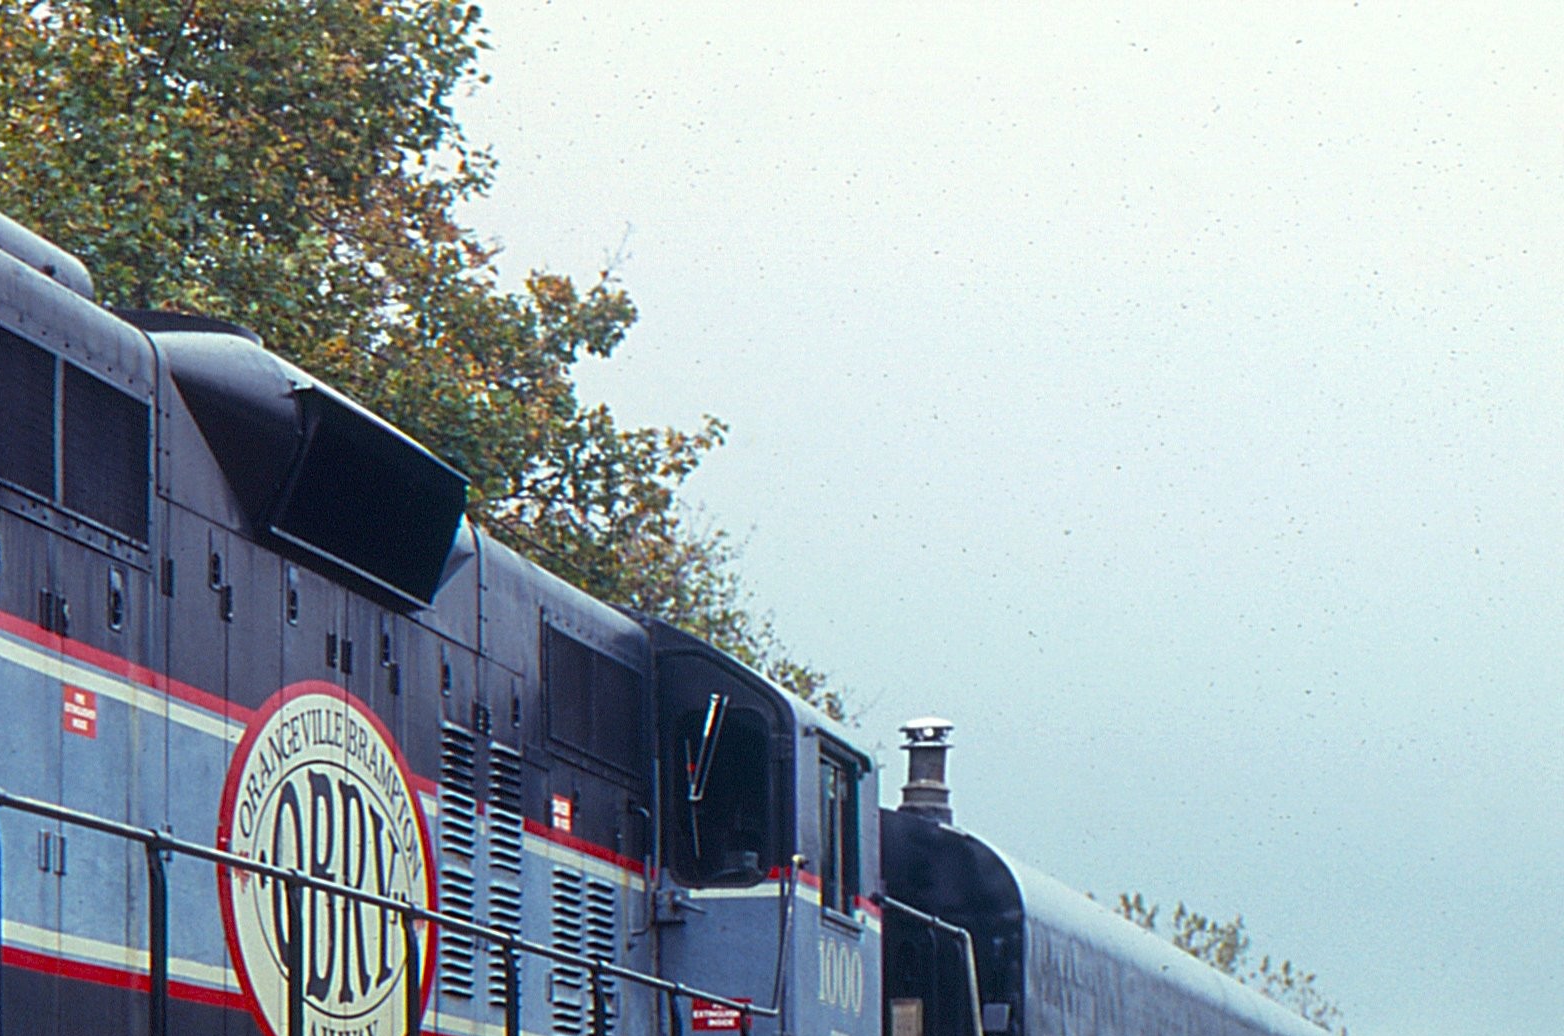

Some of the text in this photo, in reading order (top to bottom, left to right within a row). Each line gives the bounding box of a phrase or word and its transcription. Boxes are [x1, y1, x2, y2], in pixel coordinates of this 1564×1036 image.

[238, 708, 422, 882] ORANGEVILLE BRAMPTON
[272, 767, 400, 1004] OBRY
[817, 935, 864, 1018] 1000
